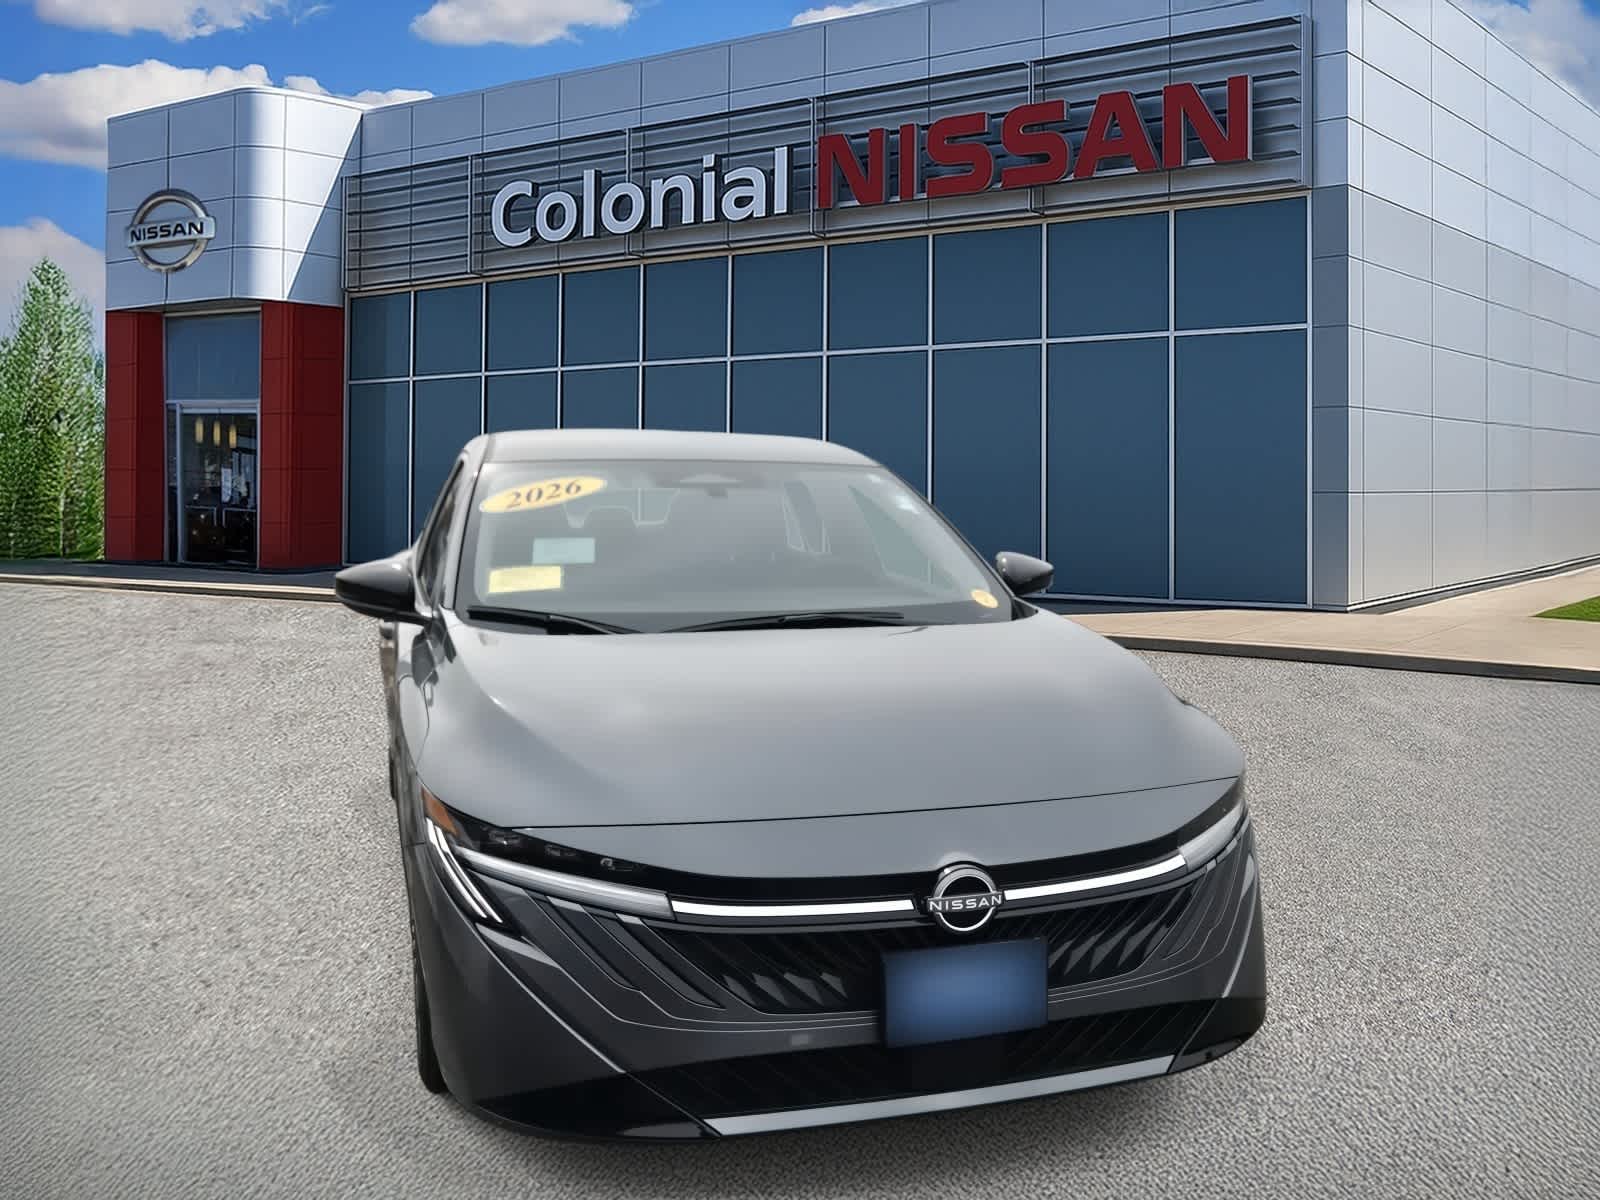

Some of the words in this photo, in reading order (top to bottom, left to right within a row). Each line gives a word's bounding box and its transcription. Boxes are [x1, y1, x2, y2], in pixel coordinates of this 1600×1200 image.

[490, 146, 791, 248] Colonial
[817, 74, 1253, 210] NISSAN
[130, 221, 204, 242] NISSAN
[506, 478, 582, 509] 2026
[929, 895, 1002, 911] NISSAN
